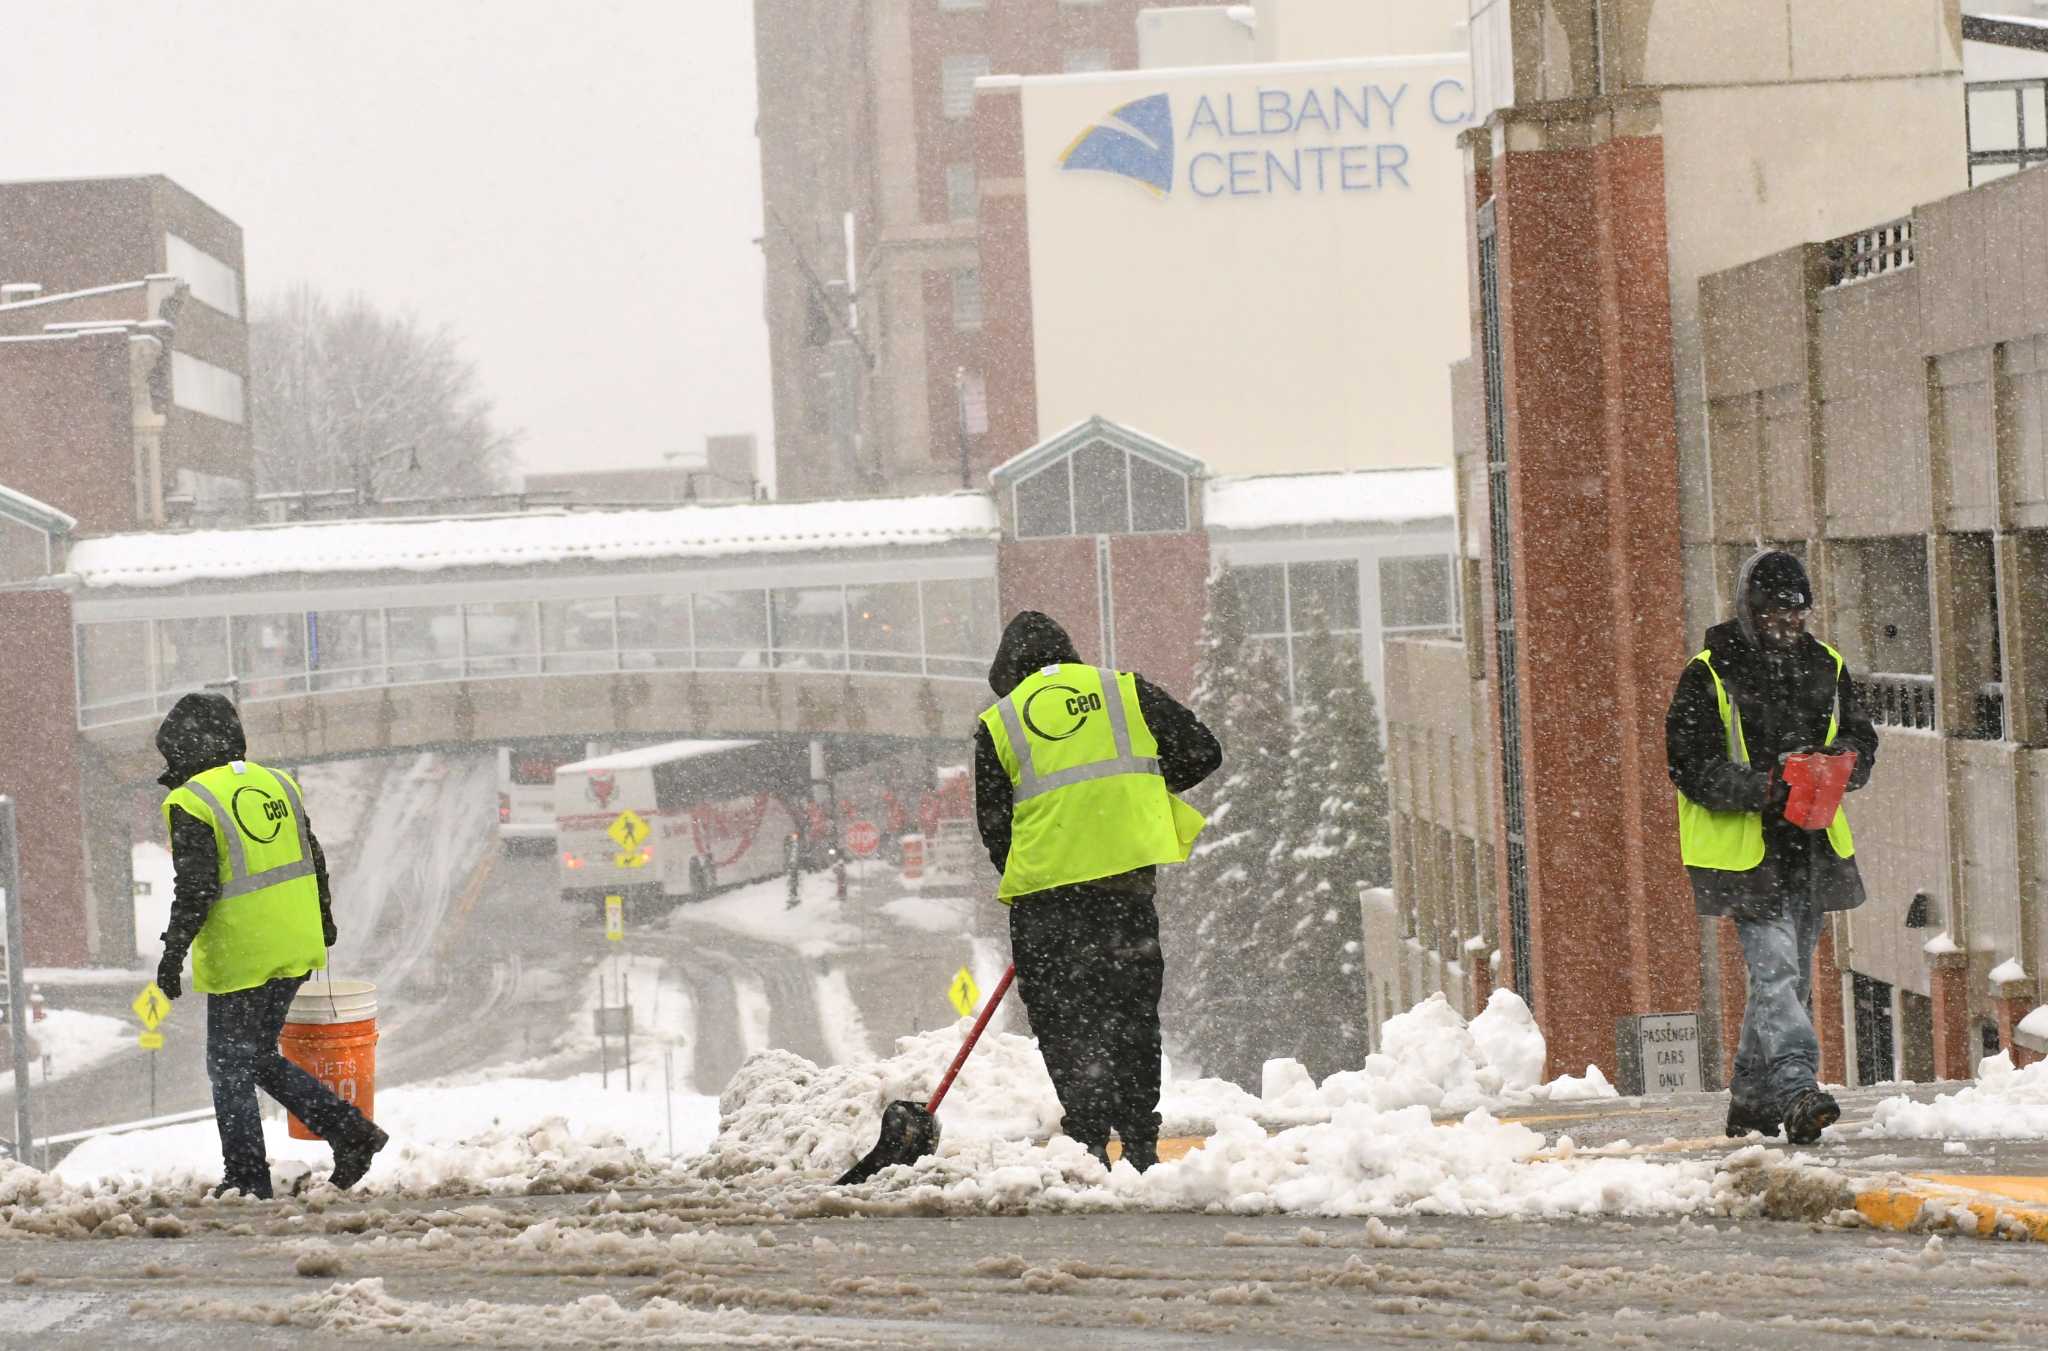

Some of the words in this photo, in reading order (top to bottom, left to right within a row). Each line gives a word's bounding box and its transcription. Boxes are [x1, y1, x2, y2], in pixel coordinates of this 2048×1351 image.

[1185, 82, 1408, 140] ALBANY
[1429, 80, 1474, 125] C
[1188, 143, 1410, 199] CENTER
[849, 831, 878, 846] STOP
[1642, 1026, 1696, 1043] PASSENGER
[1657, 1049, 1685, 1066] CARS
[1659, 1071, 1686, 1088] ONLY
